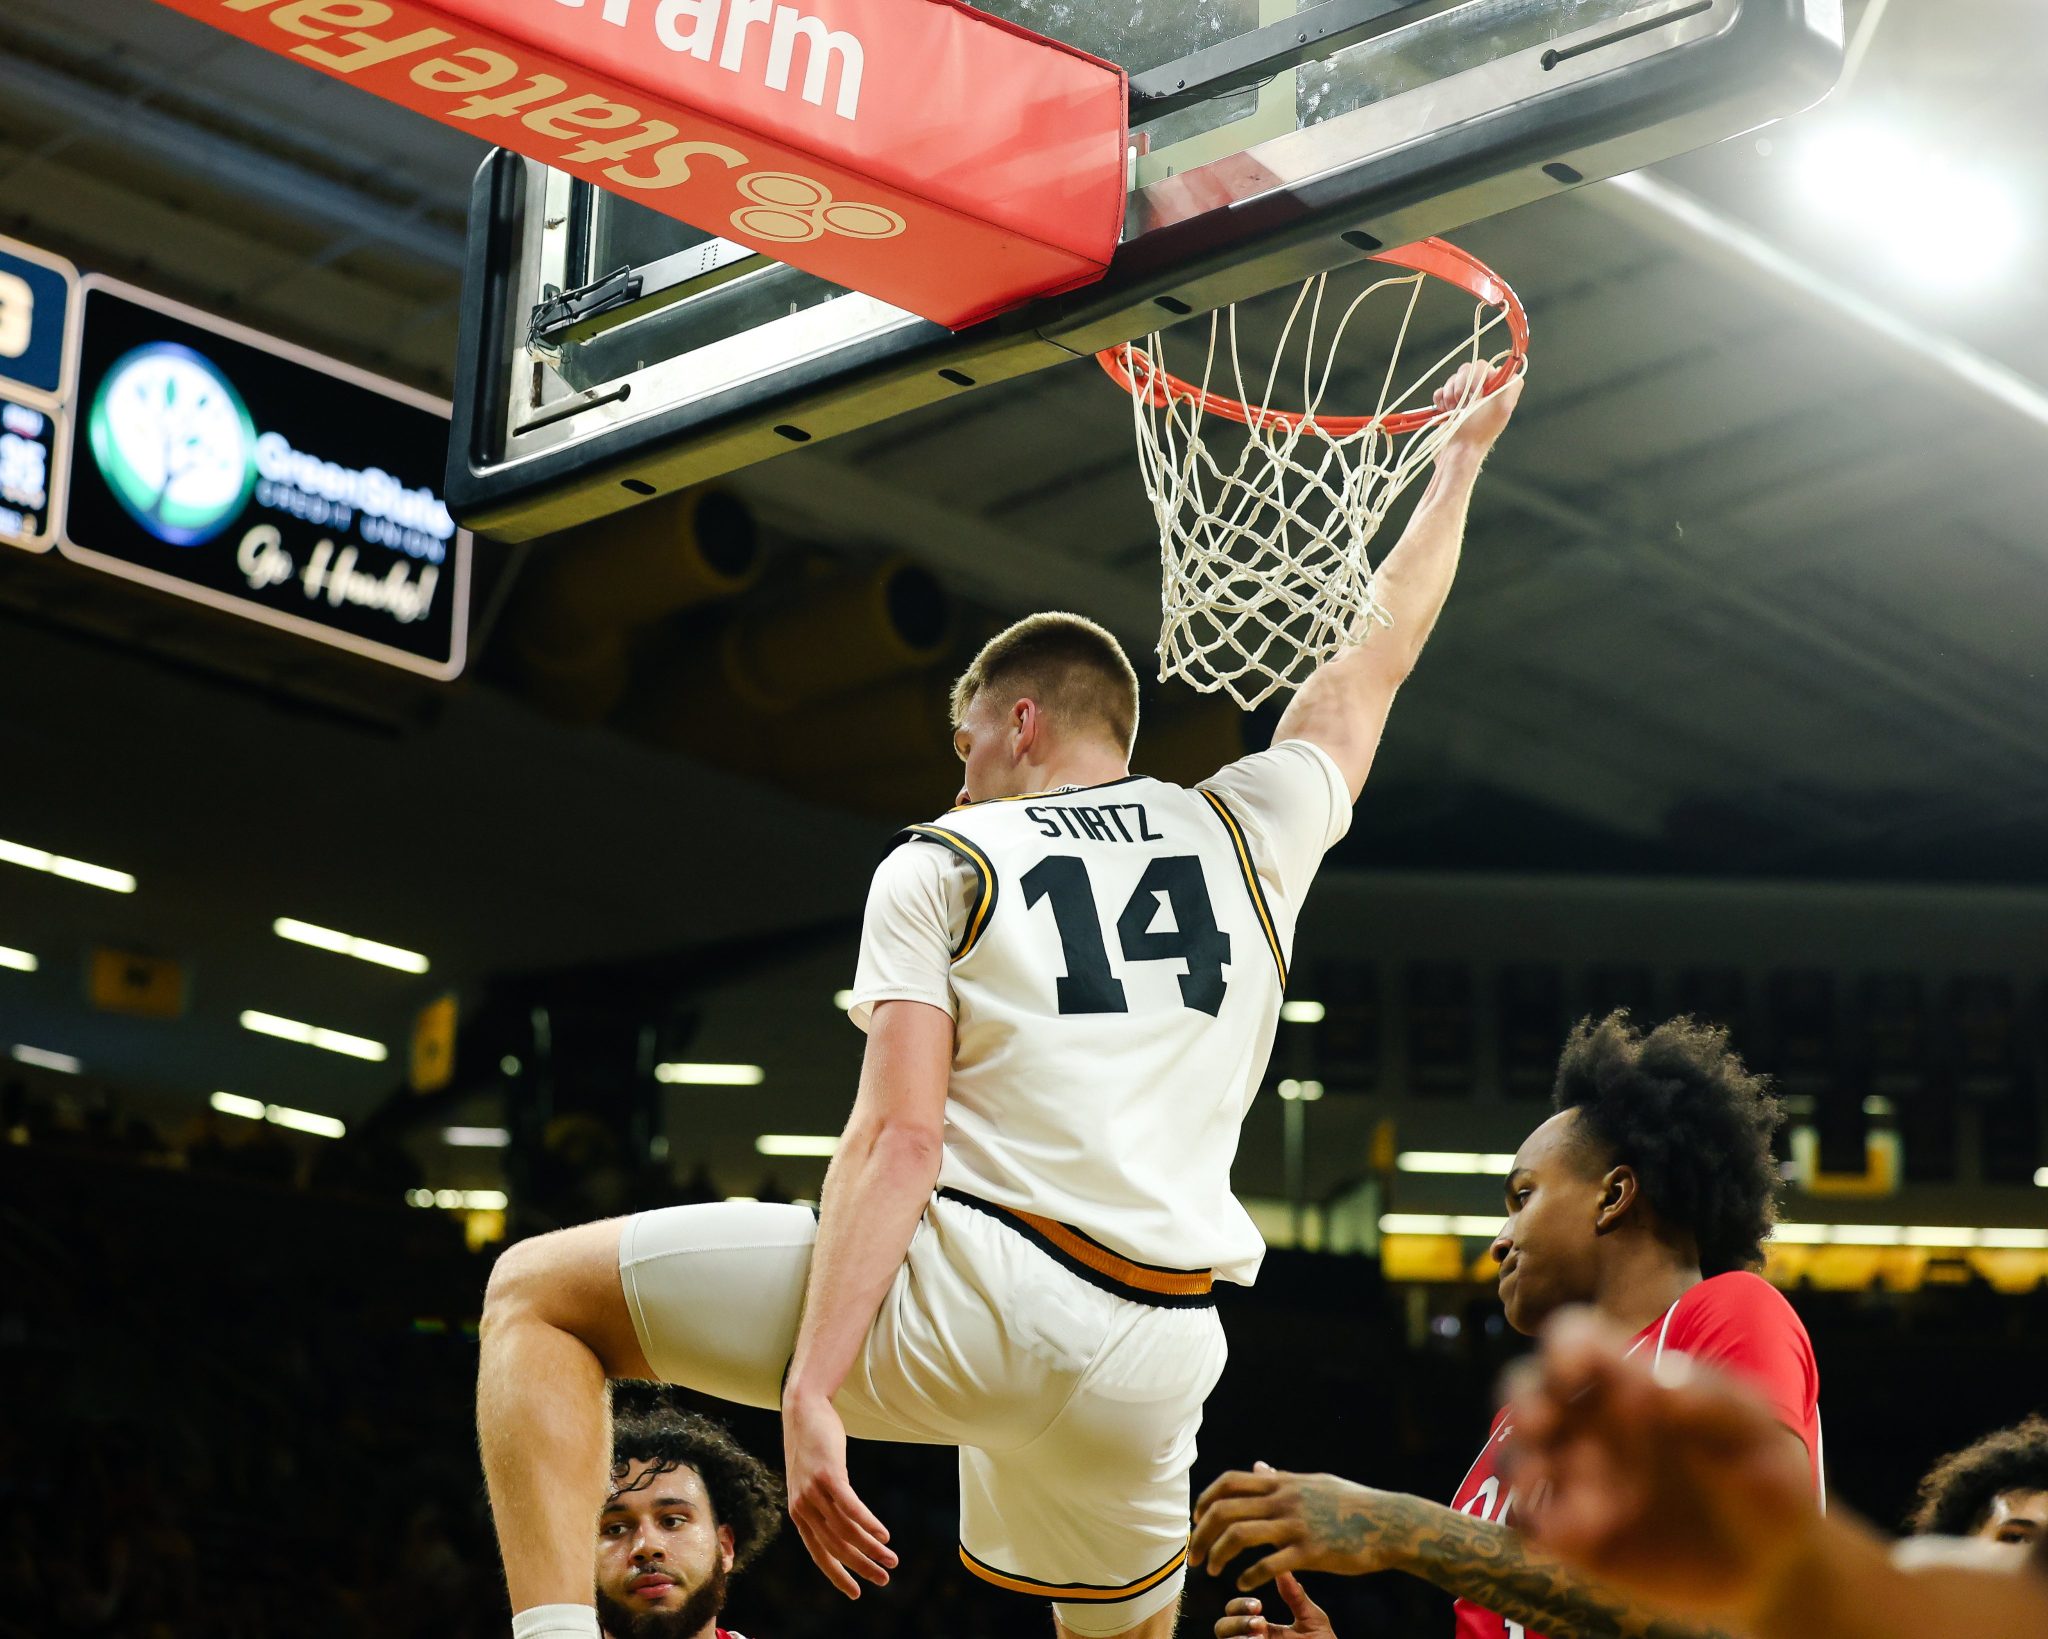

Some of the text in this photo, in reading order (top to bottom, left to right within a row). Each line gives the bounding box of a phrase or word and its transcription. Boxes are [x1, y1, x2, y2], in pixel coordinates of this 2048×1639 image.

[221, 0, 750, 189] StateFa
[554, 0, 865, 121] arm
[237, 524, 293, 590] Go
[1025, 803, 1164, 843] STIRTZ
[1019, 855, 1232, 1018] 14
